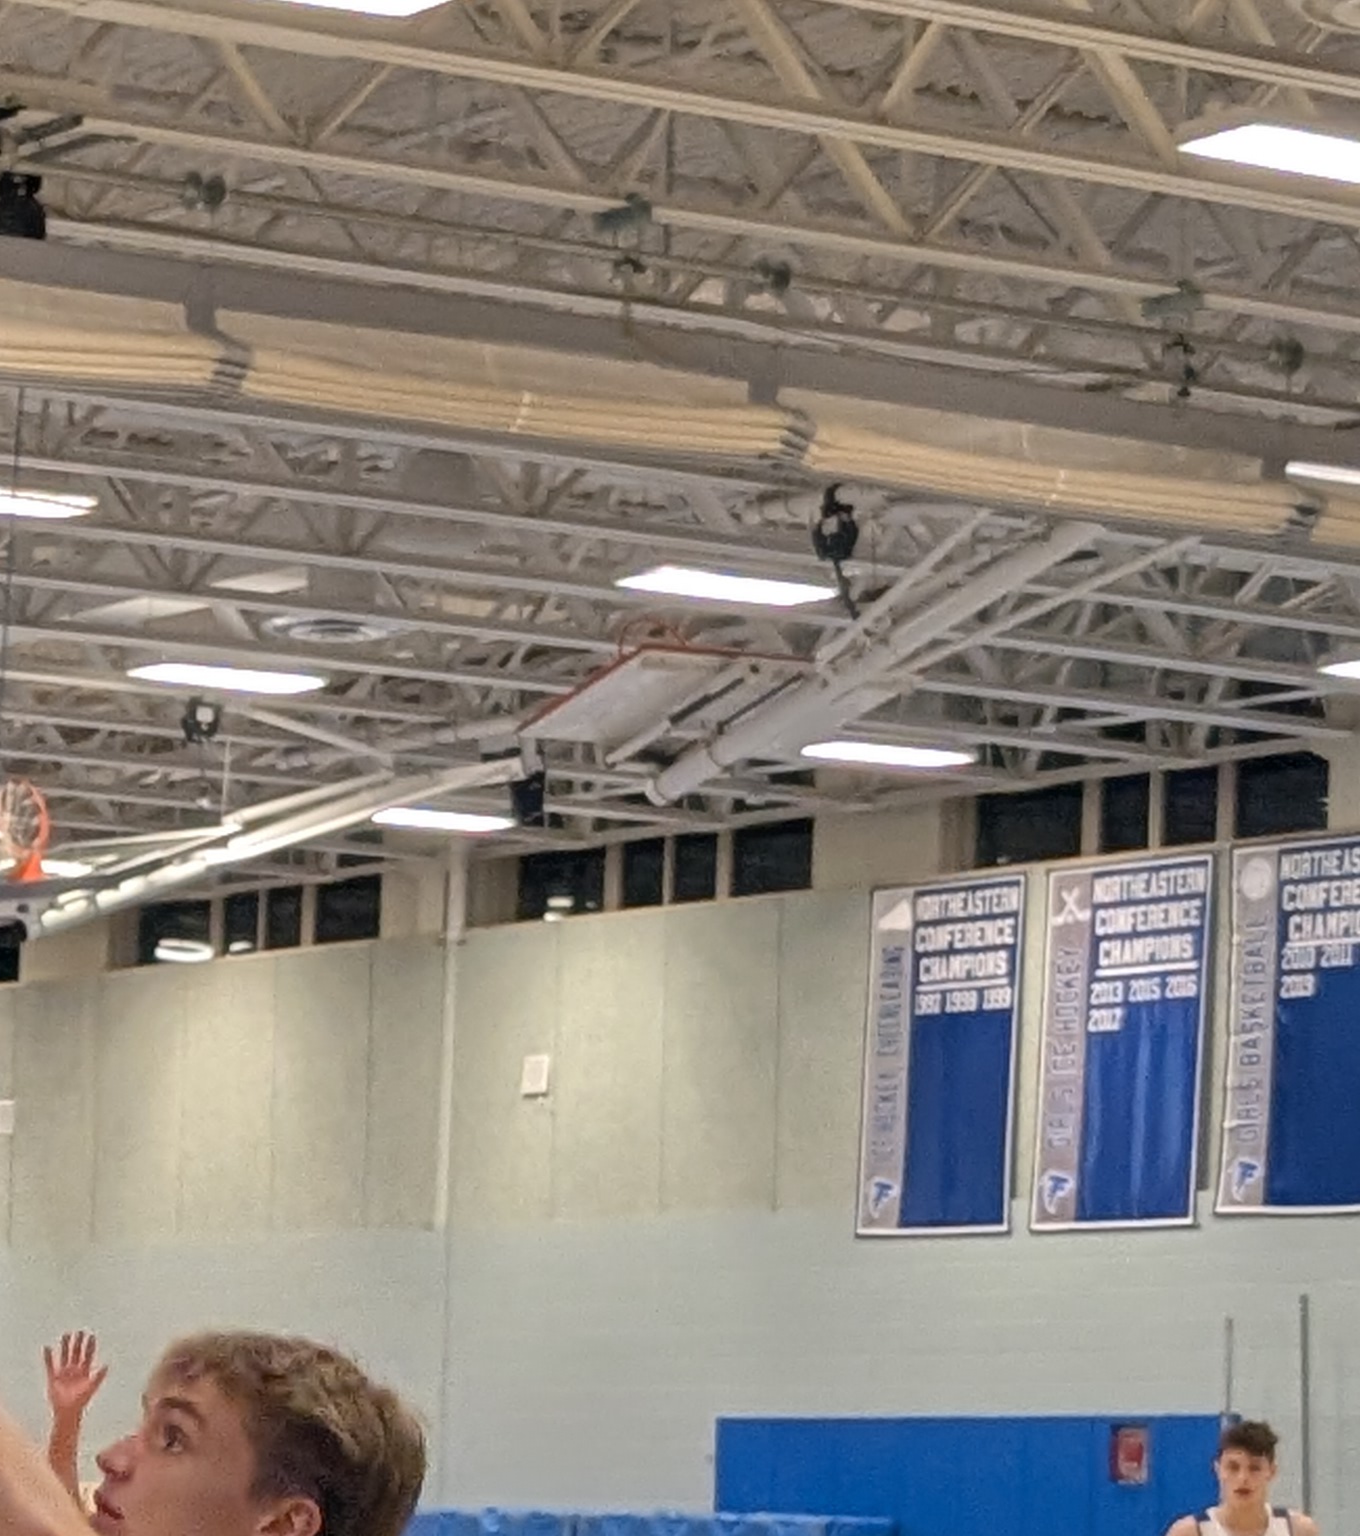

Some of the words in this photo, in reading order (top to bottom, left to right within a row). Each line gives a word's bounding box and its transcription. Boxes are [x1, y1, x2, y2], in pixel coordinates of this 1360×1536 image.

[1093, 867, 1207, 903] NORTHEASTERN
[914, 917, 1015, 953] CONFERENCE
[1095, 898, 1202, 937] CONFERENCE
[918, 950, 1008, 983] CHAMPIONS
[1099, 933, 1194, 967] CHAMPIONS
[1054, 945, 1082, 1034] HOCKEY
[1240, 912, 1272, 1067] BASKETBALL
